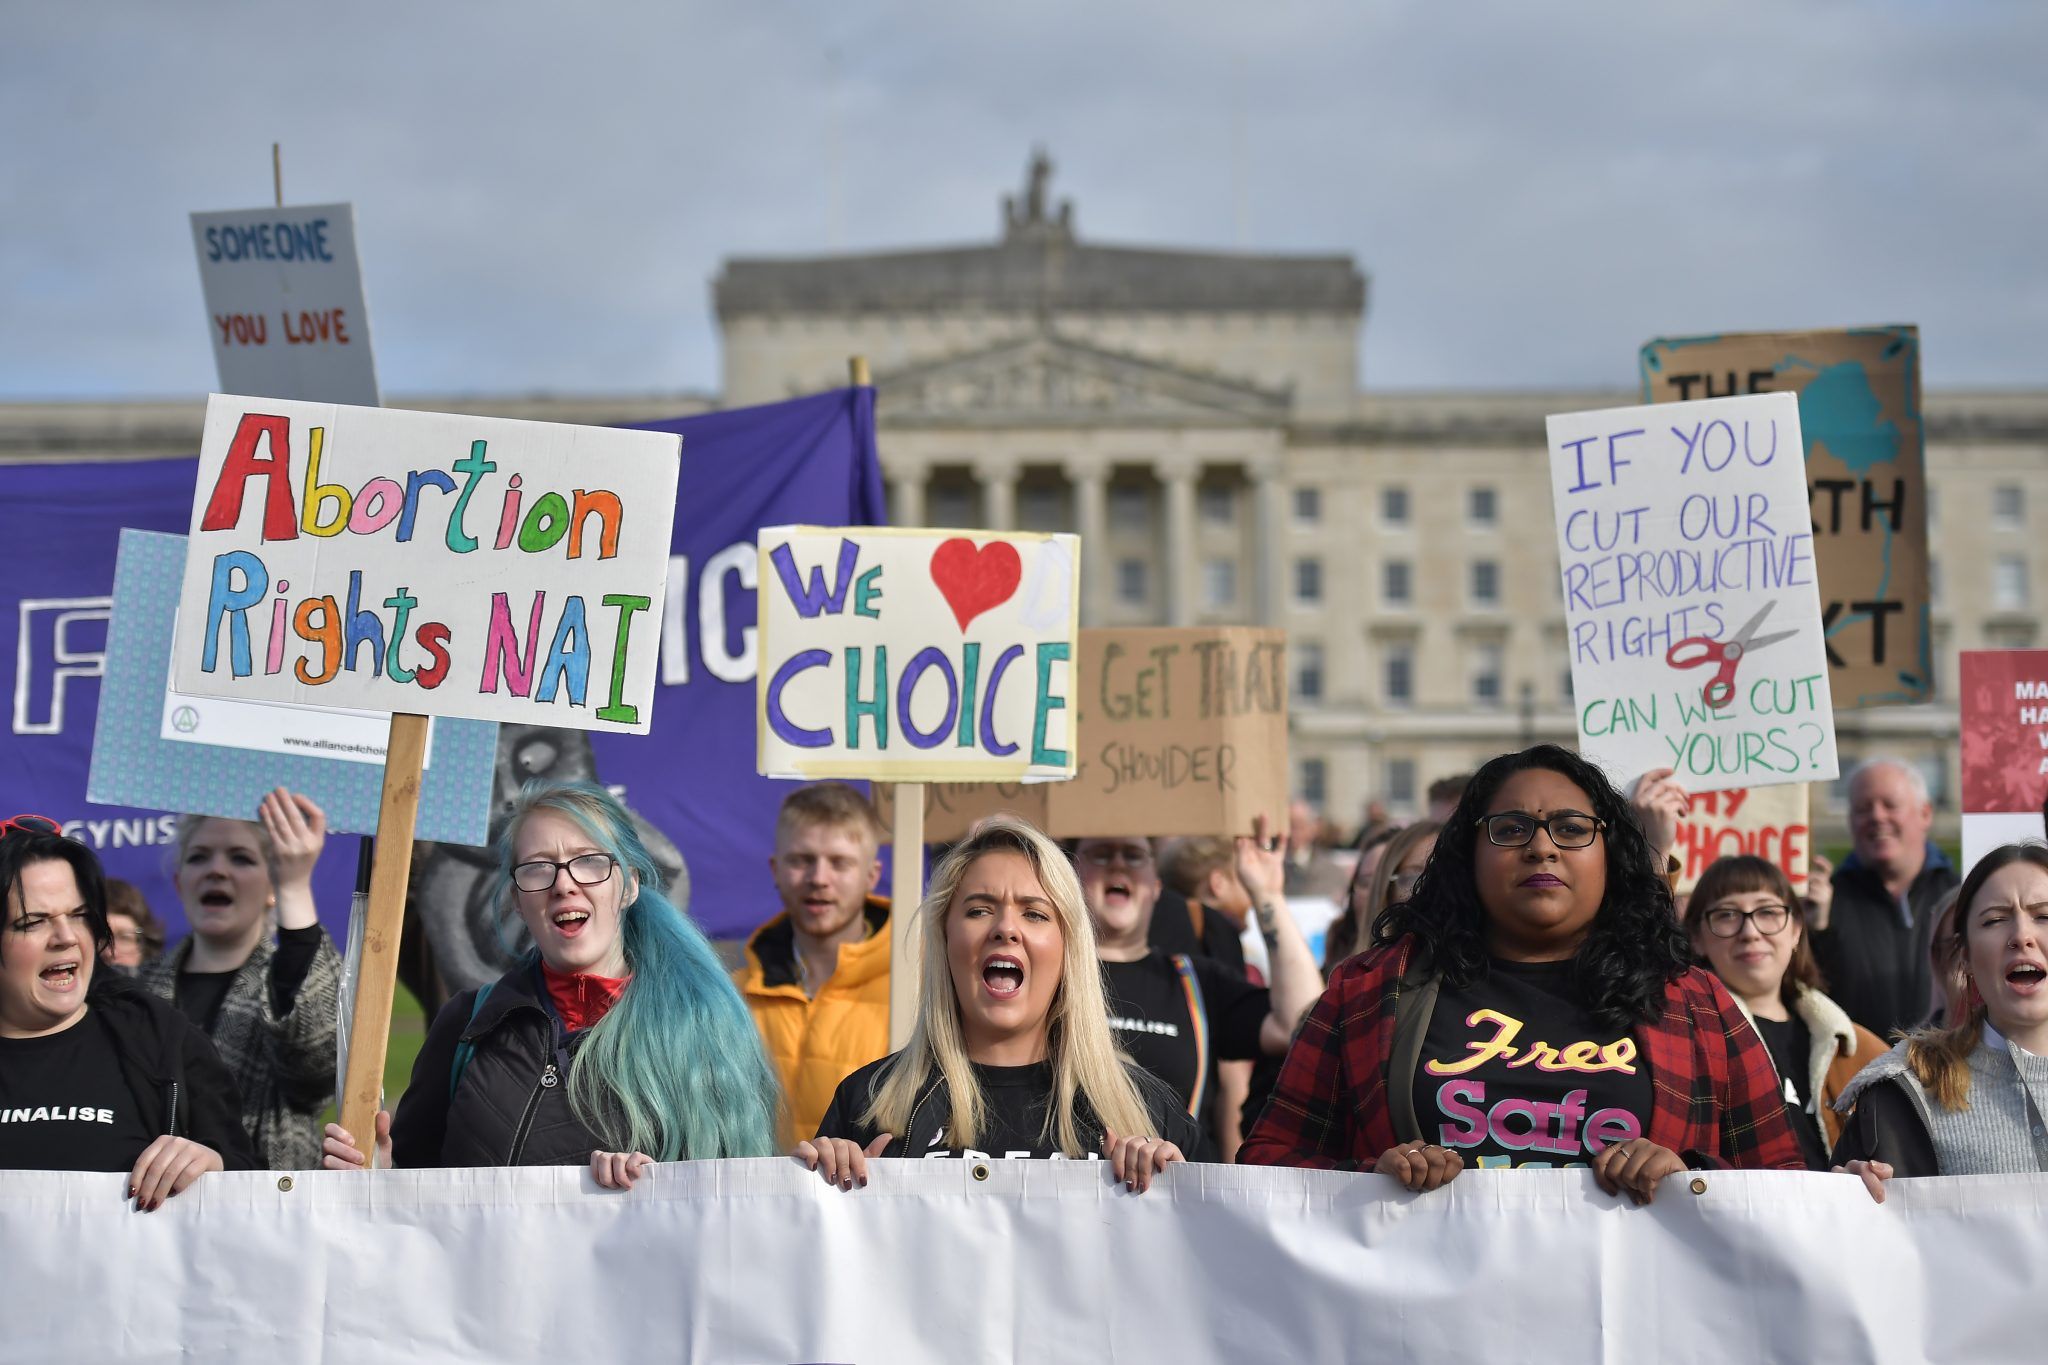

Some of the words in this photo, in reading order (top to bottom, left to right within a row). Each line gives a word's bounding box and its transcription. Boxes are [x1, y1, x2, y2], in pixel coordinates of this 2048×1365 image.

[206, 219, 333, 263] SOMEONE
[214, 314, 266, 345] YOU
[283, 308, 350, 344] LOVE
[200, 413, 623, 560] Abortion
[1561, 429, 1645, 493] IF
[1670, 419, 1777, 474] YOU
[1566, 506, 1650, 552] CUT
[1680, 493, 1777, 541] OUR
[769, 537, 882, 620] WE
[1564, 534, 1814, 611] REPRODUCTIVE
[201, 550, 452, 690] Rights
[479, 590, 651, 724] NAI
[1574, 602, 1725, 665] RIGHTS
[766, 642, 1071, 767] CHOICE
[1101, 641, 1180, 721] GET
[1191, 637, 1286, 720] THAT
[1583, 693, 1657, 736] CAN
[1675, 684, 1736, 728] WE
[1750, 674, 1823, 714] CUT
[2015, 681, 2048, 699] MA
[283, 737, 387, 756] www.alliance4choic
[1665, 723, 1824, 775] YOURS?
[1424, 1009, 1636, 1076] Free
[0, 1106, 115, 1125] INALISE
[1436, 1079, 1641, 1156] Safe
